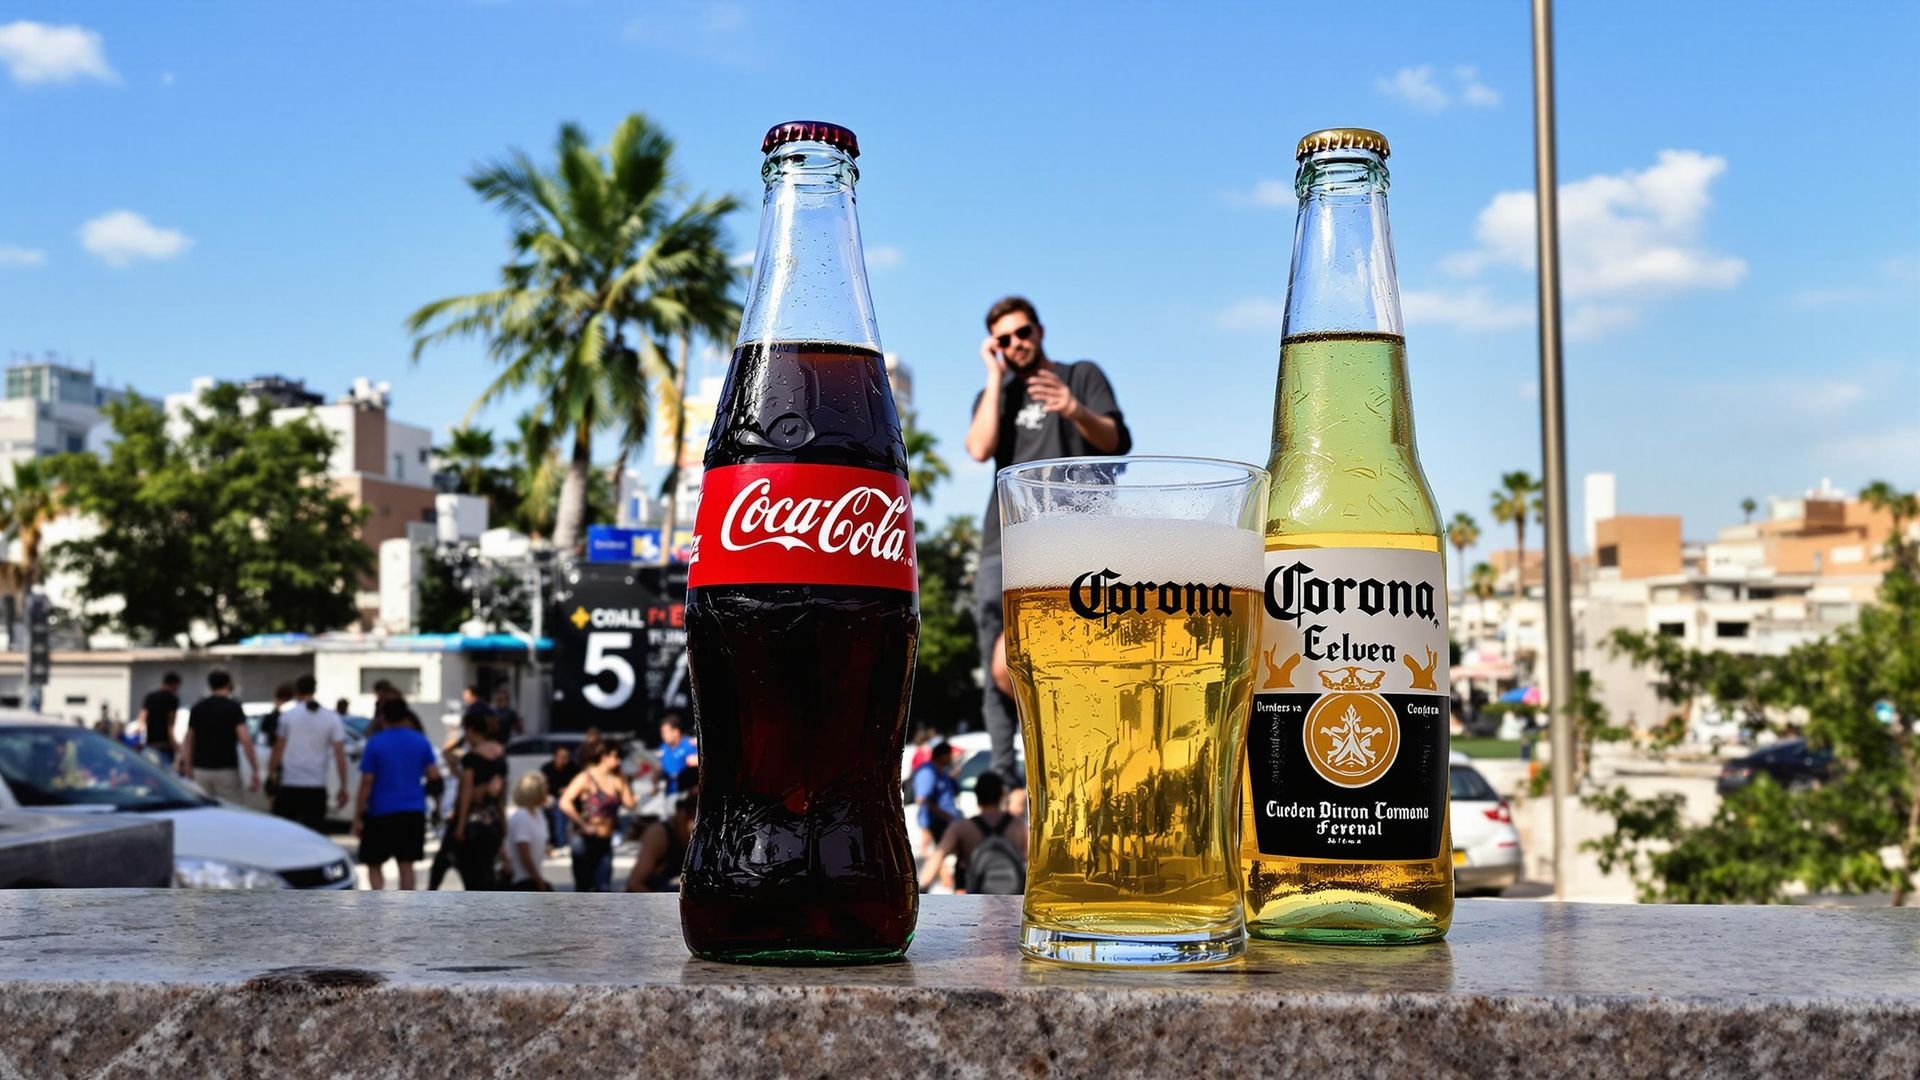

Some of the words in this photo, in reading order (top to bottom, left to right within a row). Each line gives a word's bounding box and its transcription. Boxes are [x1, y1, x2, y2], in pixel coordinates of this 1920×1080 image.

[720, 478, 908, 562] Coca-Cola
[1069, 567, 1233, 630] Corona
[1264, 561, 1436, 629] Corona
[581, 632, 636, 710] 5
